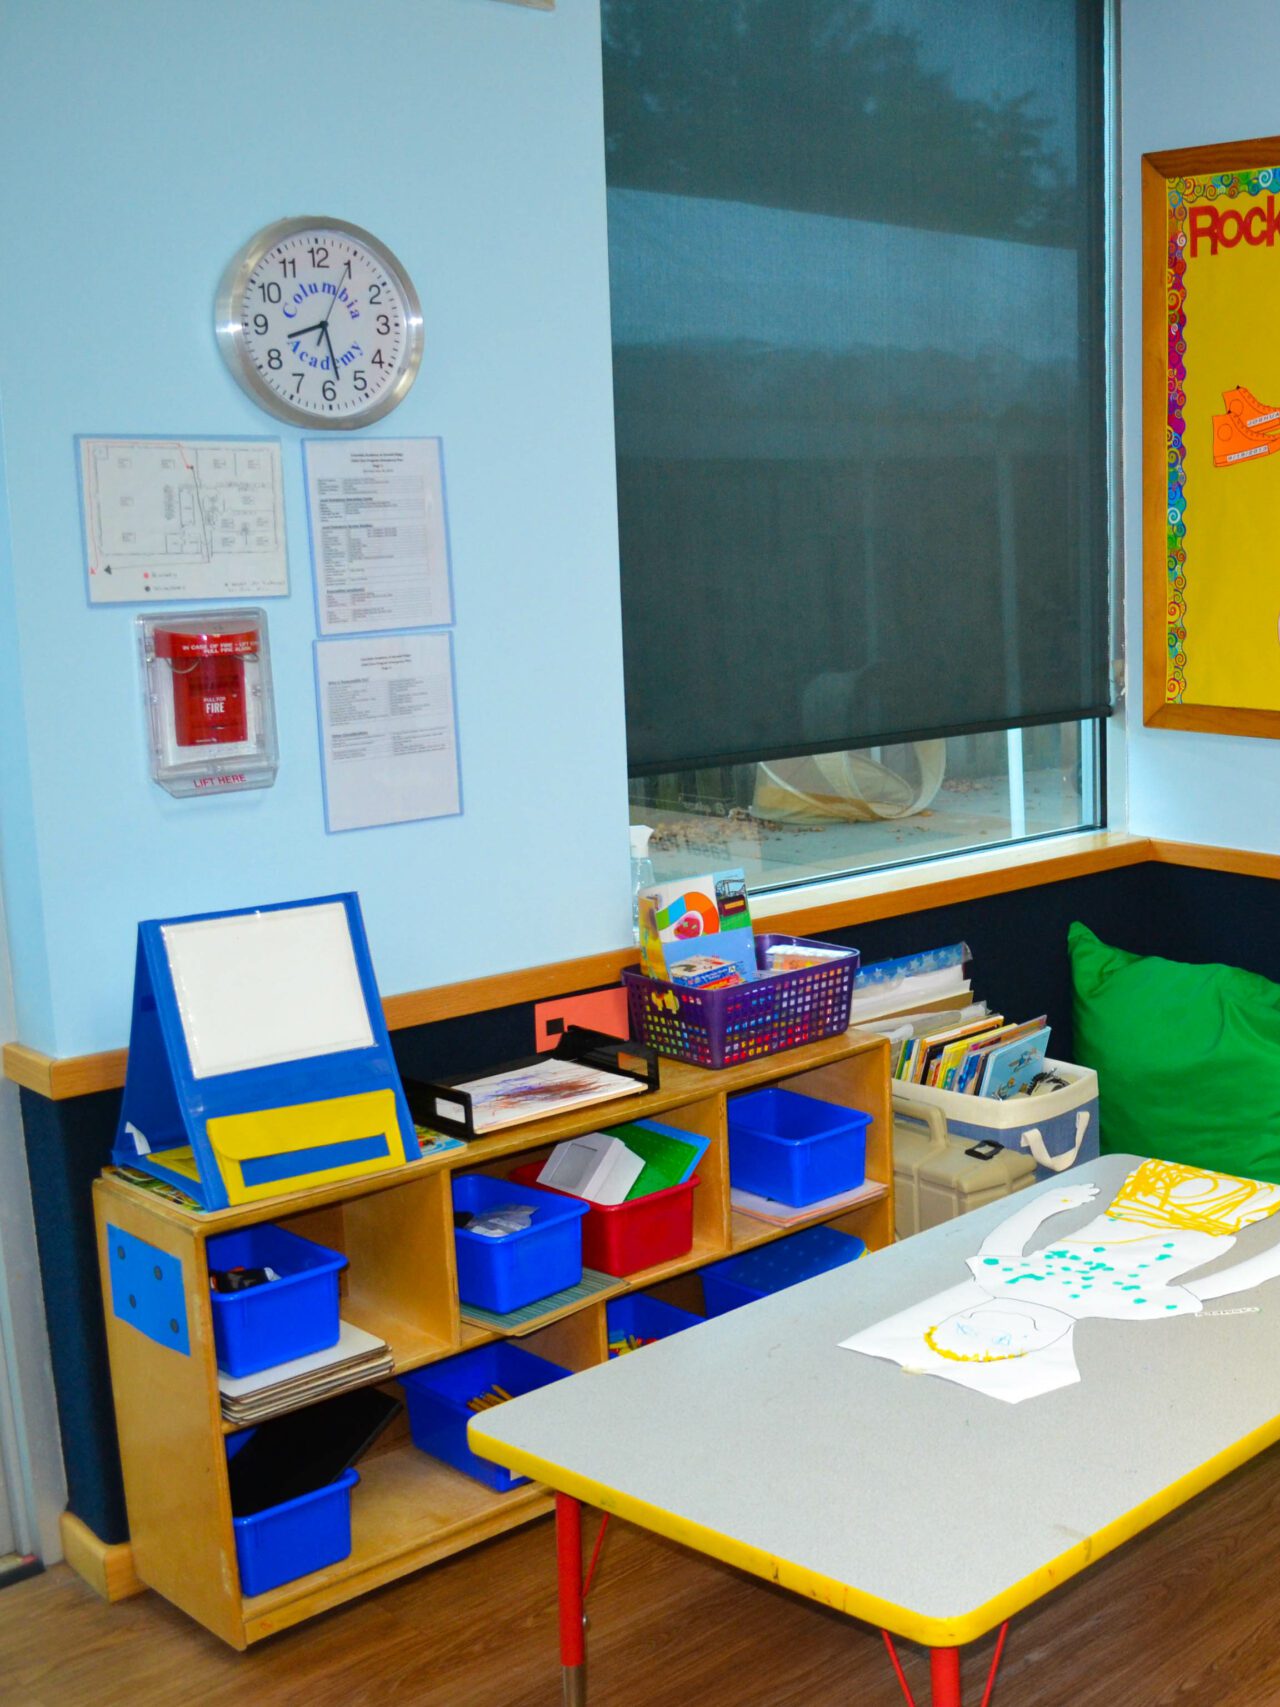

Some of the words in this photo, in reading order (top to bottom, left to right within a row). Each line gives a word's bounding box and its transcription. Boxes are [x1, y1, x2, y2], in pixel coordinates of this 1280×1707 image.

[278, 258, 297, 279] 11
[307, 247, 330, 269] 12
[343, 260, 352, 280] 1
[258, 282, 282, 304] 10
[282, 281, 361, 320] Columbia
[368, 284, 382, 305] 2
[253, 314, 269, 335] 9
[376, 314, 391, 336] 3
[267, 348, 283, 370] 8
[371, 349, 385, 369] 4
[292, 373, 305, 394] 7
[321, 380, 337, 401] 6
[353, 370, 368, 391] 5
[206, 702, 225, 714] FIRE
[193, 777, 215, 788] LIFT
[217, 773, 247, 785] HERE
